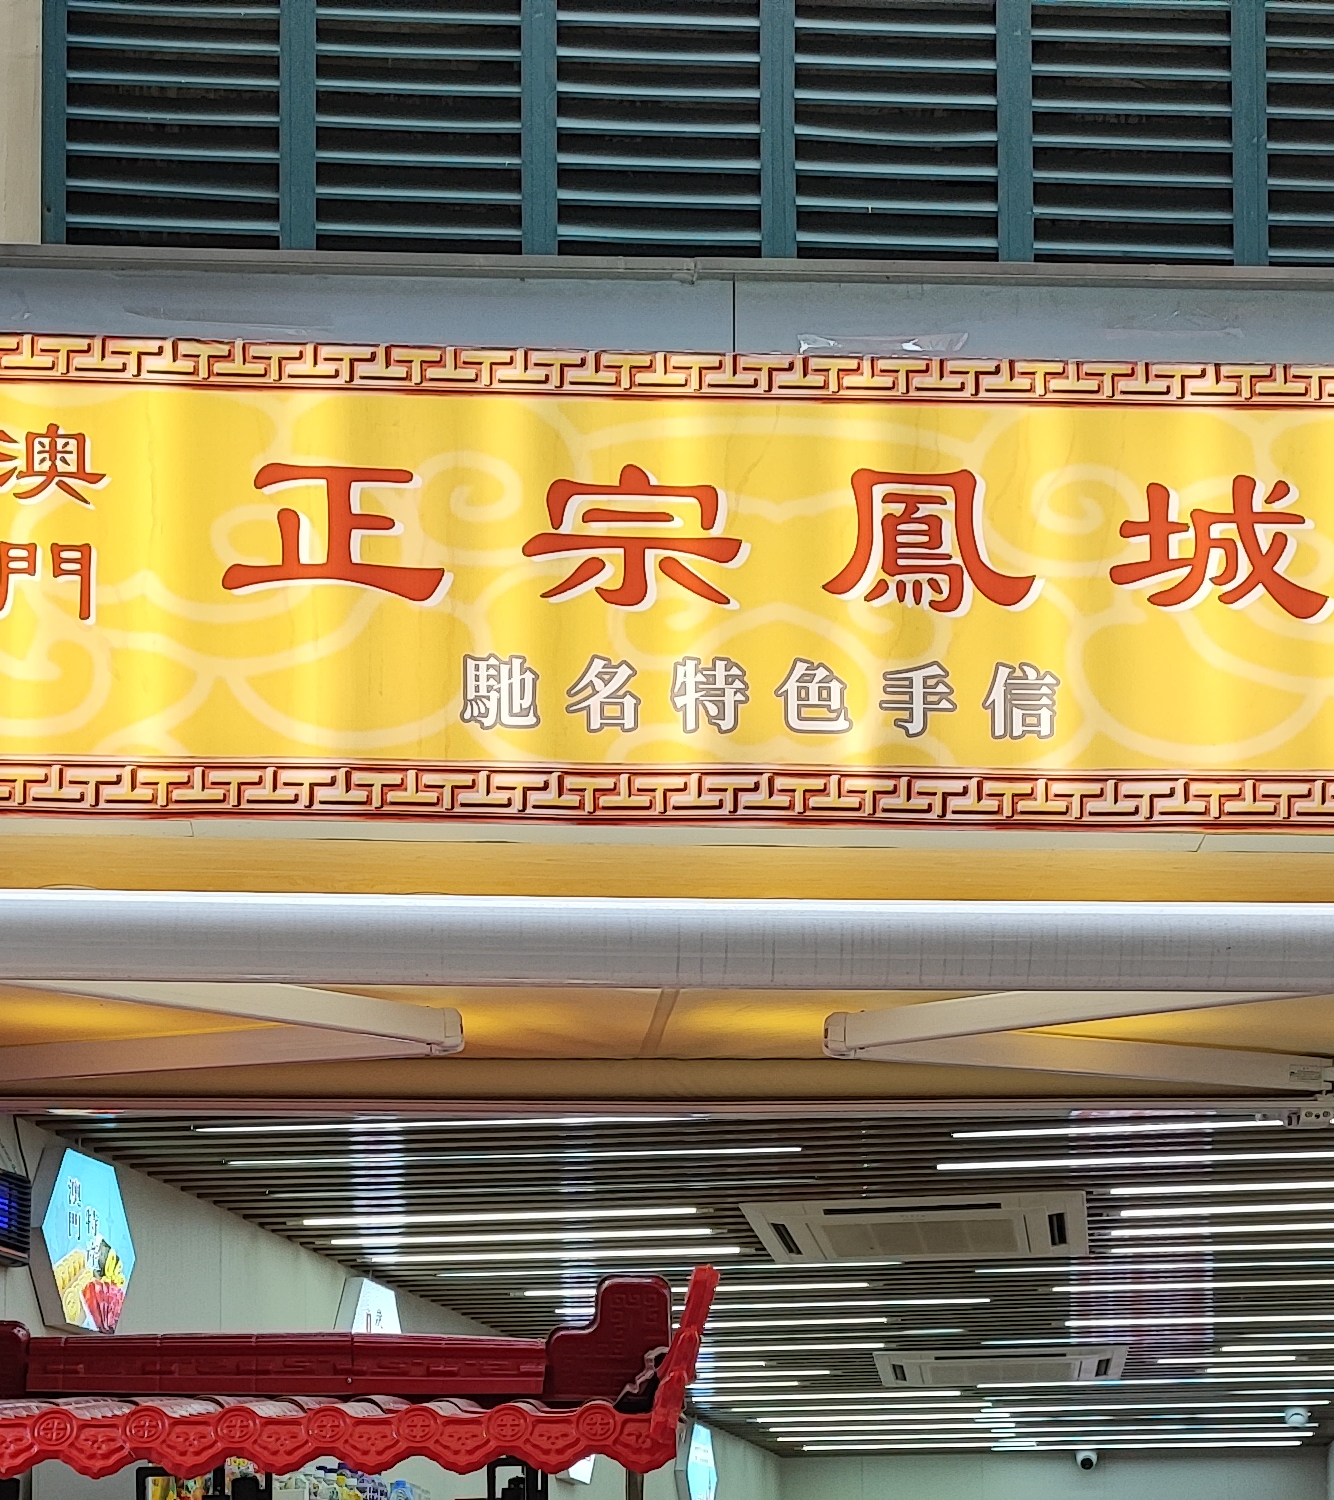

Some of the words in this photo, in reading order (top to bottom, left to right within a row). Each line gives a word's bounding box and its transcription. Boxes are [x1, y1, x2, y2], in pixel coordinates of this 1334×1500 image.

[222, 463, 1334, 622] 正宗鳳城
[461, 654, 1061, 740] 馳名特色手信
